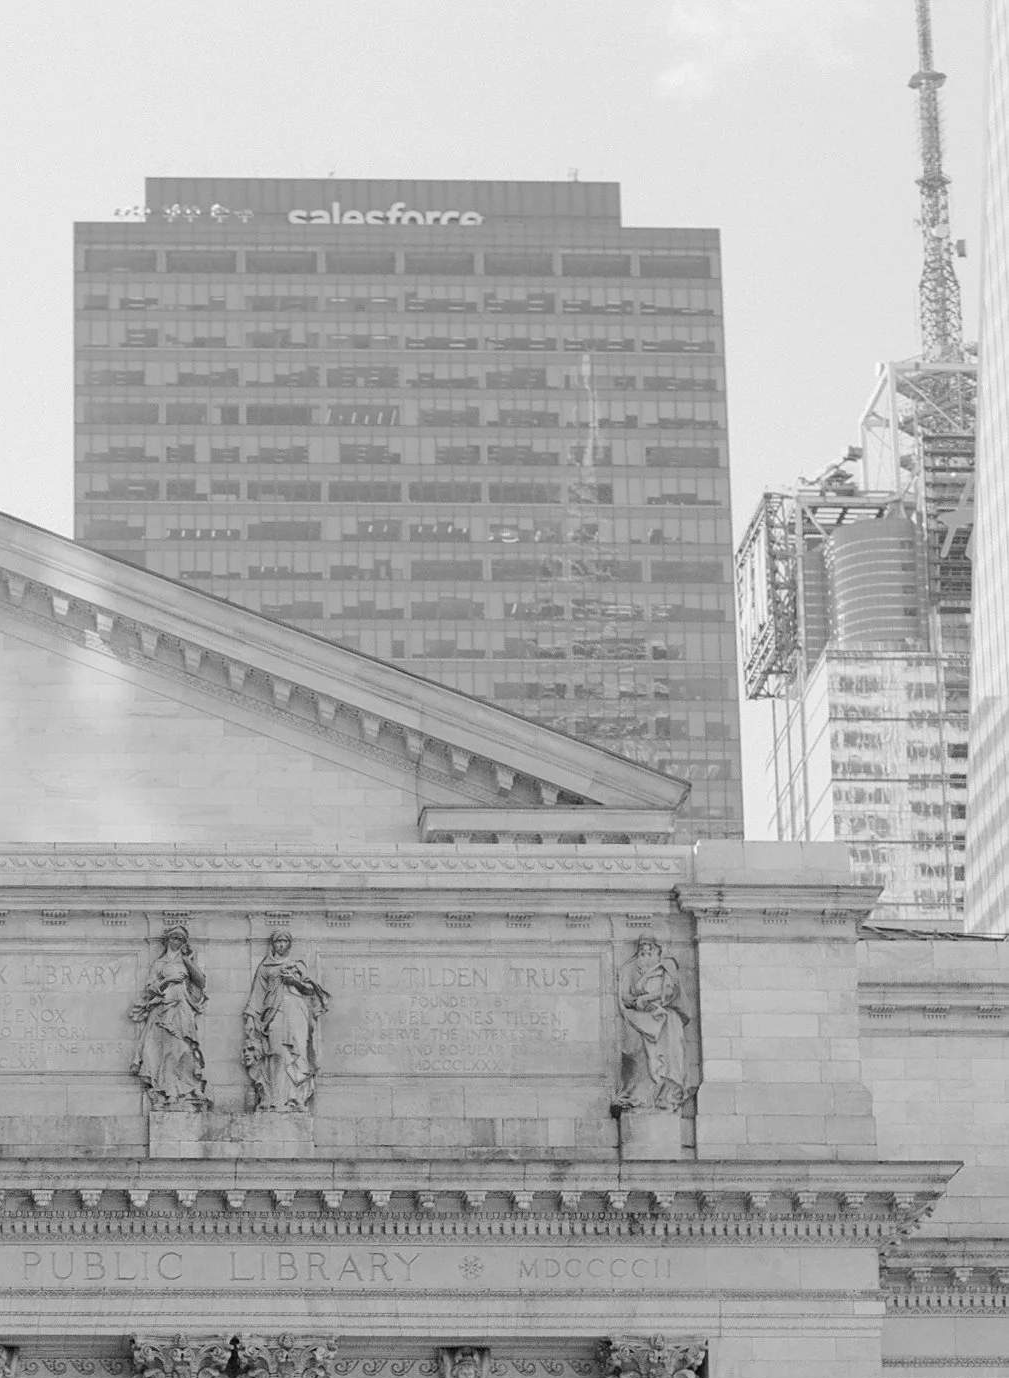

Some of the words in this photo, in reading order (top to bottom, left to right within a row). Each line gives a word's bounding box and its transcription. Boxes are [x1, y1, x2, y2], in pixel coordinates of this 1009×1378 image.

[287, 201, 483, 226] salesforce
[22, 964, 122, 984] LIBRARY
[335, 967, 381, 987] THE
[403, 967, 488, 987] TILDEN
[509, 967, 586, 987] TRUST
[30, 994, 46, 1005] BY
[411, 996, 478, 1008] FOUNDED
[494, 996, 509, 1008] BY
[3, 1009, 66, 1023] LENOX
[365, 1011, 430, 1025] SAMUEL
[439, 1011, 494, 1025] JONES
[503, 1011, 562, 1025] TILDEN
[24, 1026, 88, 1038] HISTORY
[378, 1028, 420, 1040] SERVE
[430, 1028, 458, 1040] THE
[467, 1028, 543, 1040] INTERESTS
[551, 1028, 570, 1040] OF
[12, 1042, 38, 1054] THE
[47, 1042, 78, 1054] FINE
[87, 1042, 125, 1054] ARTS
[335, 1044, 395, 1056] SCIENCE
[406, 1044, 432, 1056] AND
[439, 1044, 504, 1056] POPULAR
[21, 1251, 184, 1281] PUBLIC
[230, 1251, 423, 1282] LIBRARY
[519, 1257, 672, 1279] MDCCCCII
